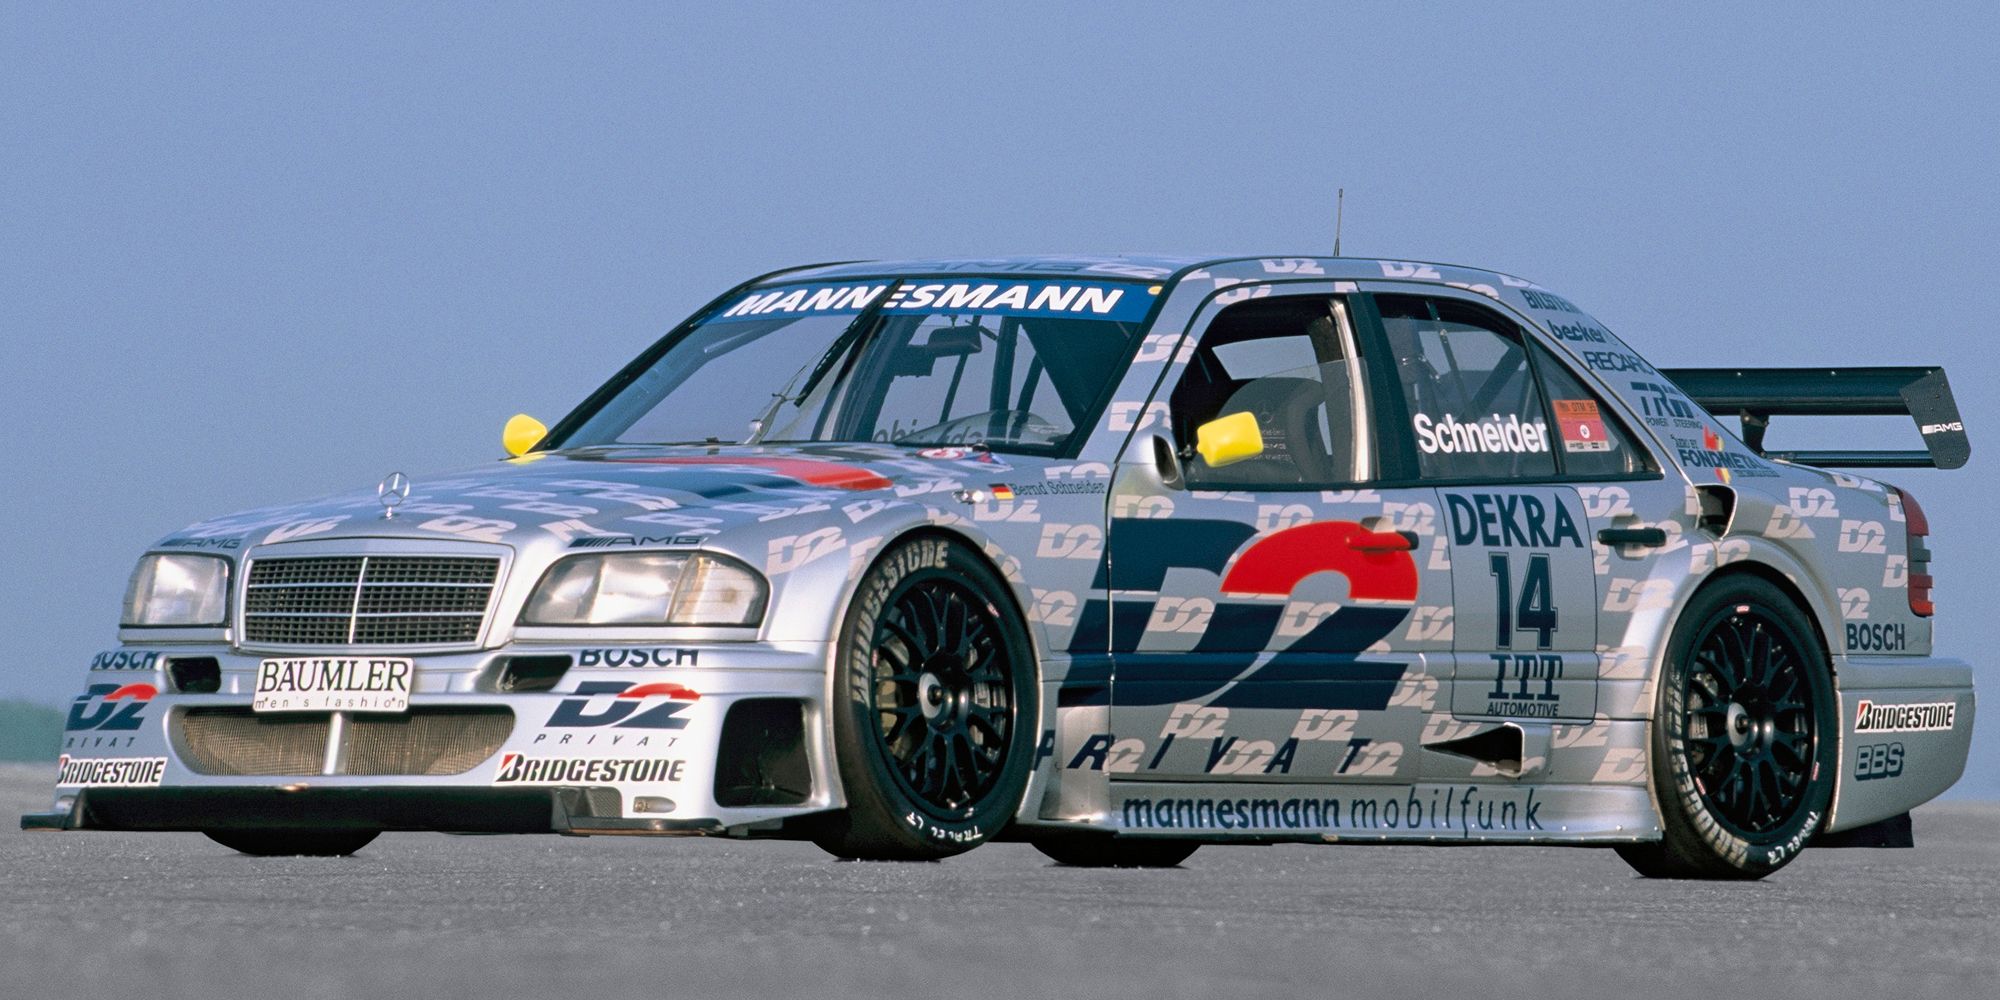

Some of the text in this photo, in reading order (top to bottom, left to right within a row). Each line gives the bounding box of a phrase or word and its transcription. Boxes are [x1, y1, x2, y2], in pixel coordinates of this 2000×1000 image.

[723, 284, 1124, 317] MANNESMANN
[1413, 412, 1549, 454] Schneider
[1646, 417, 1703, 429] POWER STEERING
[1932, 422, 1963, 433] AMG
[1678, 449, 1771, 469] FONDMETAL
[1012, 481, 1105, 496] Bernd Schneider
[1788, 487, 1839, 518] D2
[1445, 493, 1584, 548] DEKRA
[1838, 519, 1887, 554] D2
[609, 536, 702, 547] AMG
[766, 526, 847, 576] D2
[1036, 523, 1102, 560] D2
[1058, 517, 1418, 711] D2
[1488, 551, 1558, 650] 14
[1846, 623, 1905, 651] BOSCH
[579, 648, 699, 667] BOSCH
[258, 660, 409, 693] BÄUMLER
[1488, 654, 1563, 701] ITT
[65, 682, 159, 732] D2
[325, 696, 405, 709] fashion
[544, 681, 701, 730] D2
[1486, 702, 1558, 717] AUTOMOTIVE
[1856, 702, 1954, 730] BRIDGESTONE
[533, 733, 678, 748] PRIVAT
[1291, 708, 1359, 741] D2
[66, 737, 136, 749] RIVAT
[57, 755, 165, 785] BRIDGESTONE
[495, 753, 686, 782] BRIDGESTONE
[1854, 742, 1905, 781] BBS
[1122, 786, 1544, 839] mannesmann mobilfunk
